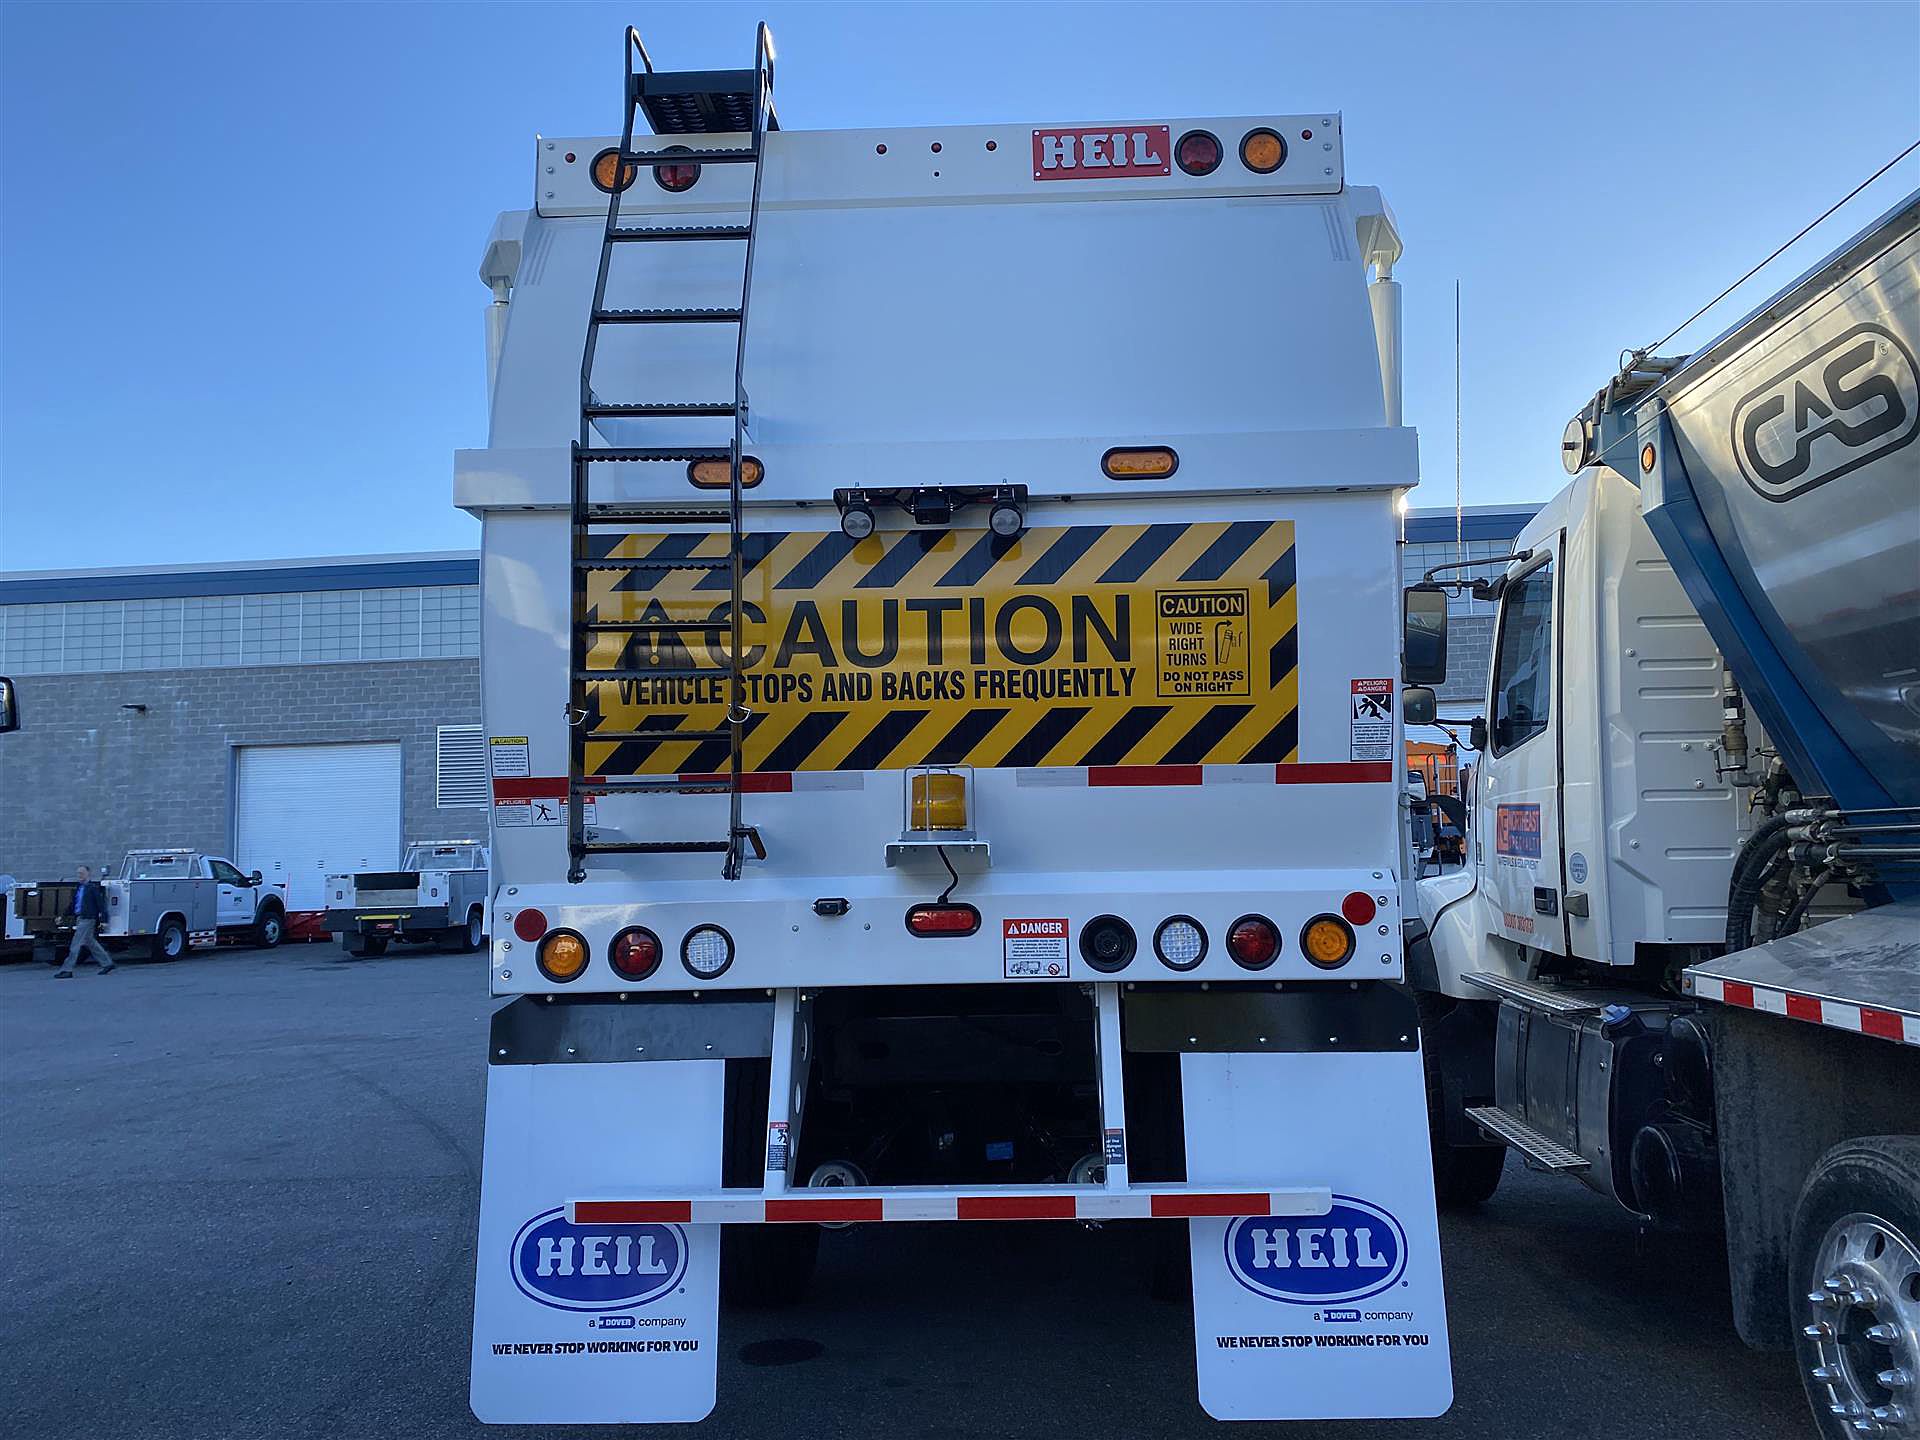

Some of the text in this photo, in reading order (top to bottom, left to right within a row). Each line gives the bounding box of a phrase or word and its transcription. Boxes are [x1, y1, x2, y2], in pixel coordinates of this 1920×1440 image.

[1042, 133, 1162, 169] HEIL
[1743, 340, 1906, 485] CAS
[1162, 597, 1243, 615] CAUTION
[704, 594, 1131, 668] CAUTION
[1170, 622, 1202, 634] WIDE
[1169, 638, 1204, 650] RIGHT
[1166, 653, 1207, 666] TURNS
[1163, 670, 1244, 681] DO NOT PASS
[618, 677, 724, 706] VEHICLE
[821, 672, 872, 701] AND
[881, 670, 965, 700] BACKS
[975, 668, 1136, 702] FREQUENTLY
[1174, 682, 1233, 692] ON RIGHT
[1020, 922, 1063, 934] DANGER
[1251, 1227, 1388, 1268] HEIL
[536, 1236, 668, 1277] HEIL
[589, 1317, 687, 1328] a DOVER company
[1313, 1310, 1414, 1321] a DOVER company
[492, 1340, 699, 1355] WE NEVER STOP WORKING FOR YOU
[1216, 1334, 1429, 1348] WE NEVER STOP WORKING FOR YOU
